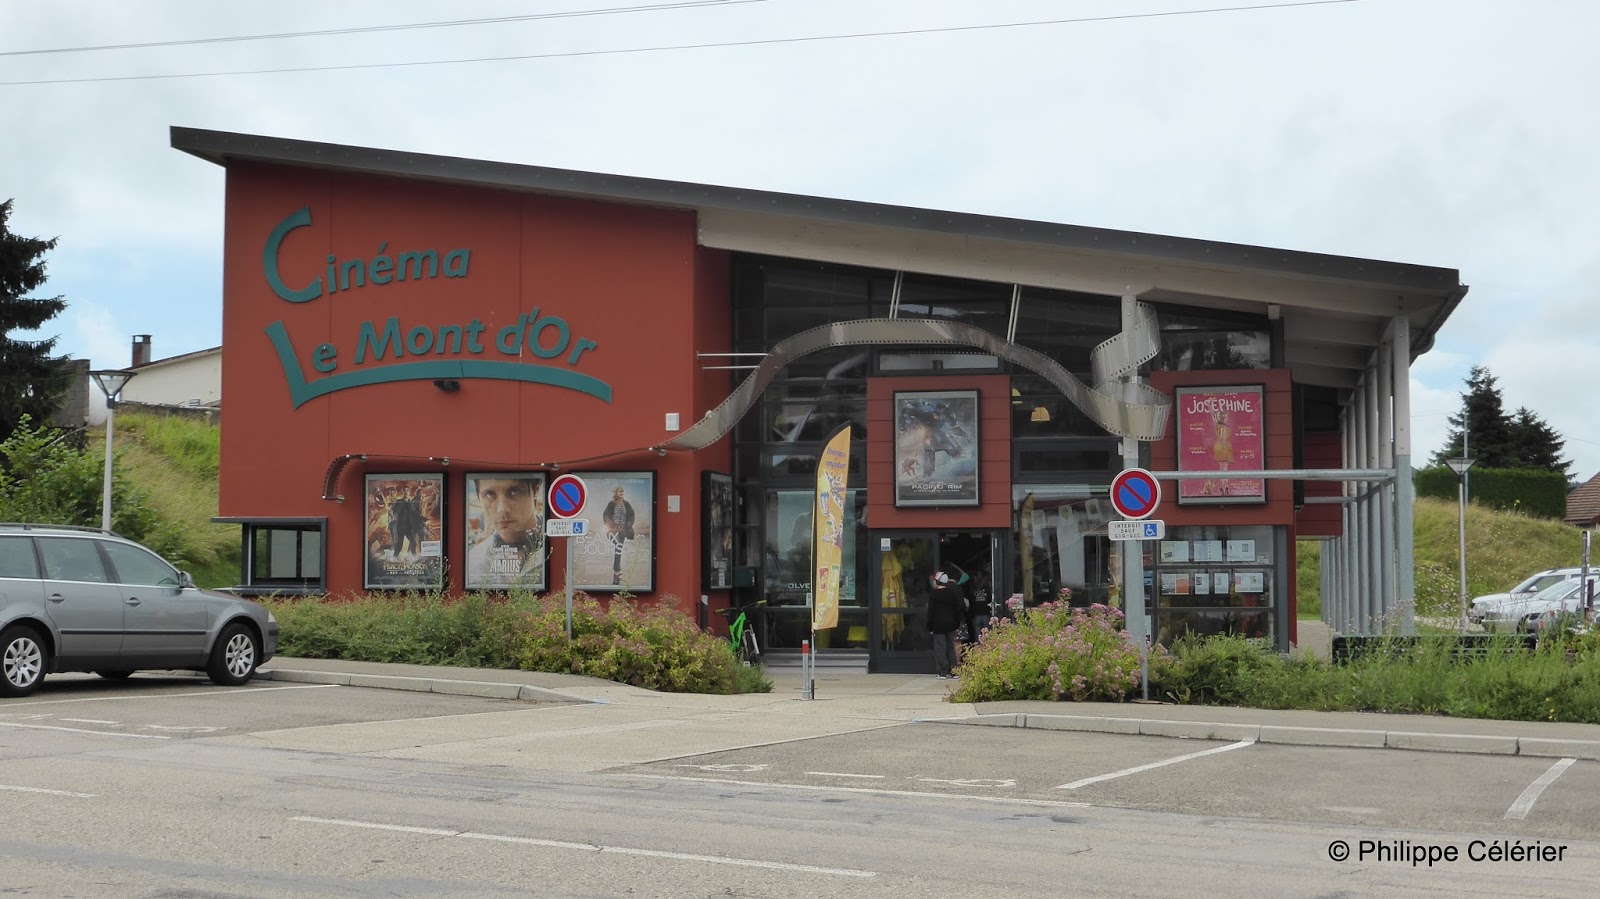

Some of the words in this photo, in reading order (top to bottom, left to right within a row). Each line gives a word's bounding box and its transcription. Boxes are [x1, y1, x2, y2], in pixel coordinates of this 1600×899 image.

[263, 206, 470, 303] Cinéma
[264, 320, 338, 411] Le
[354, 316, 486, 365] Mont
[496, 306, 597, 365] d'Or
[490, 559, 521, 573] MARIUS
[581, 543, 624, 555] JOURS
